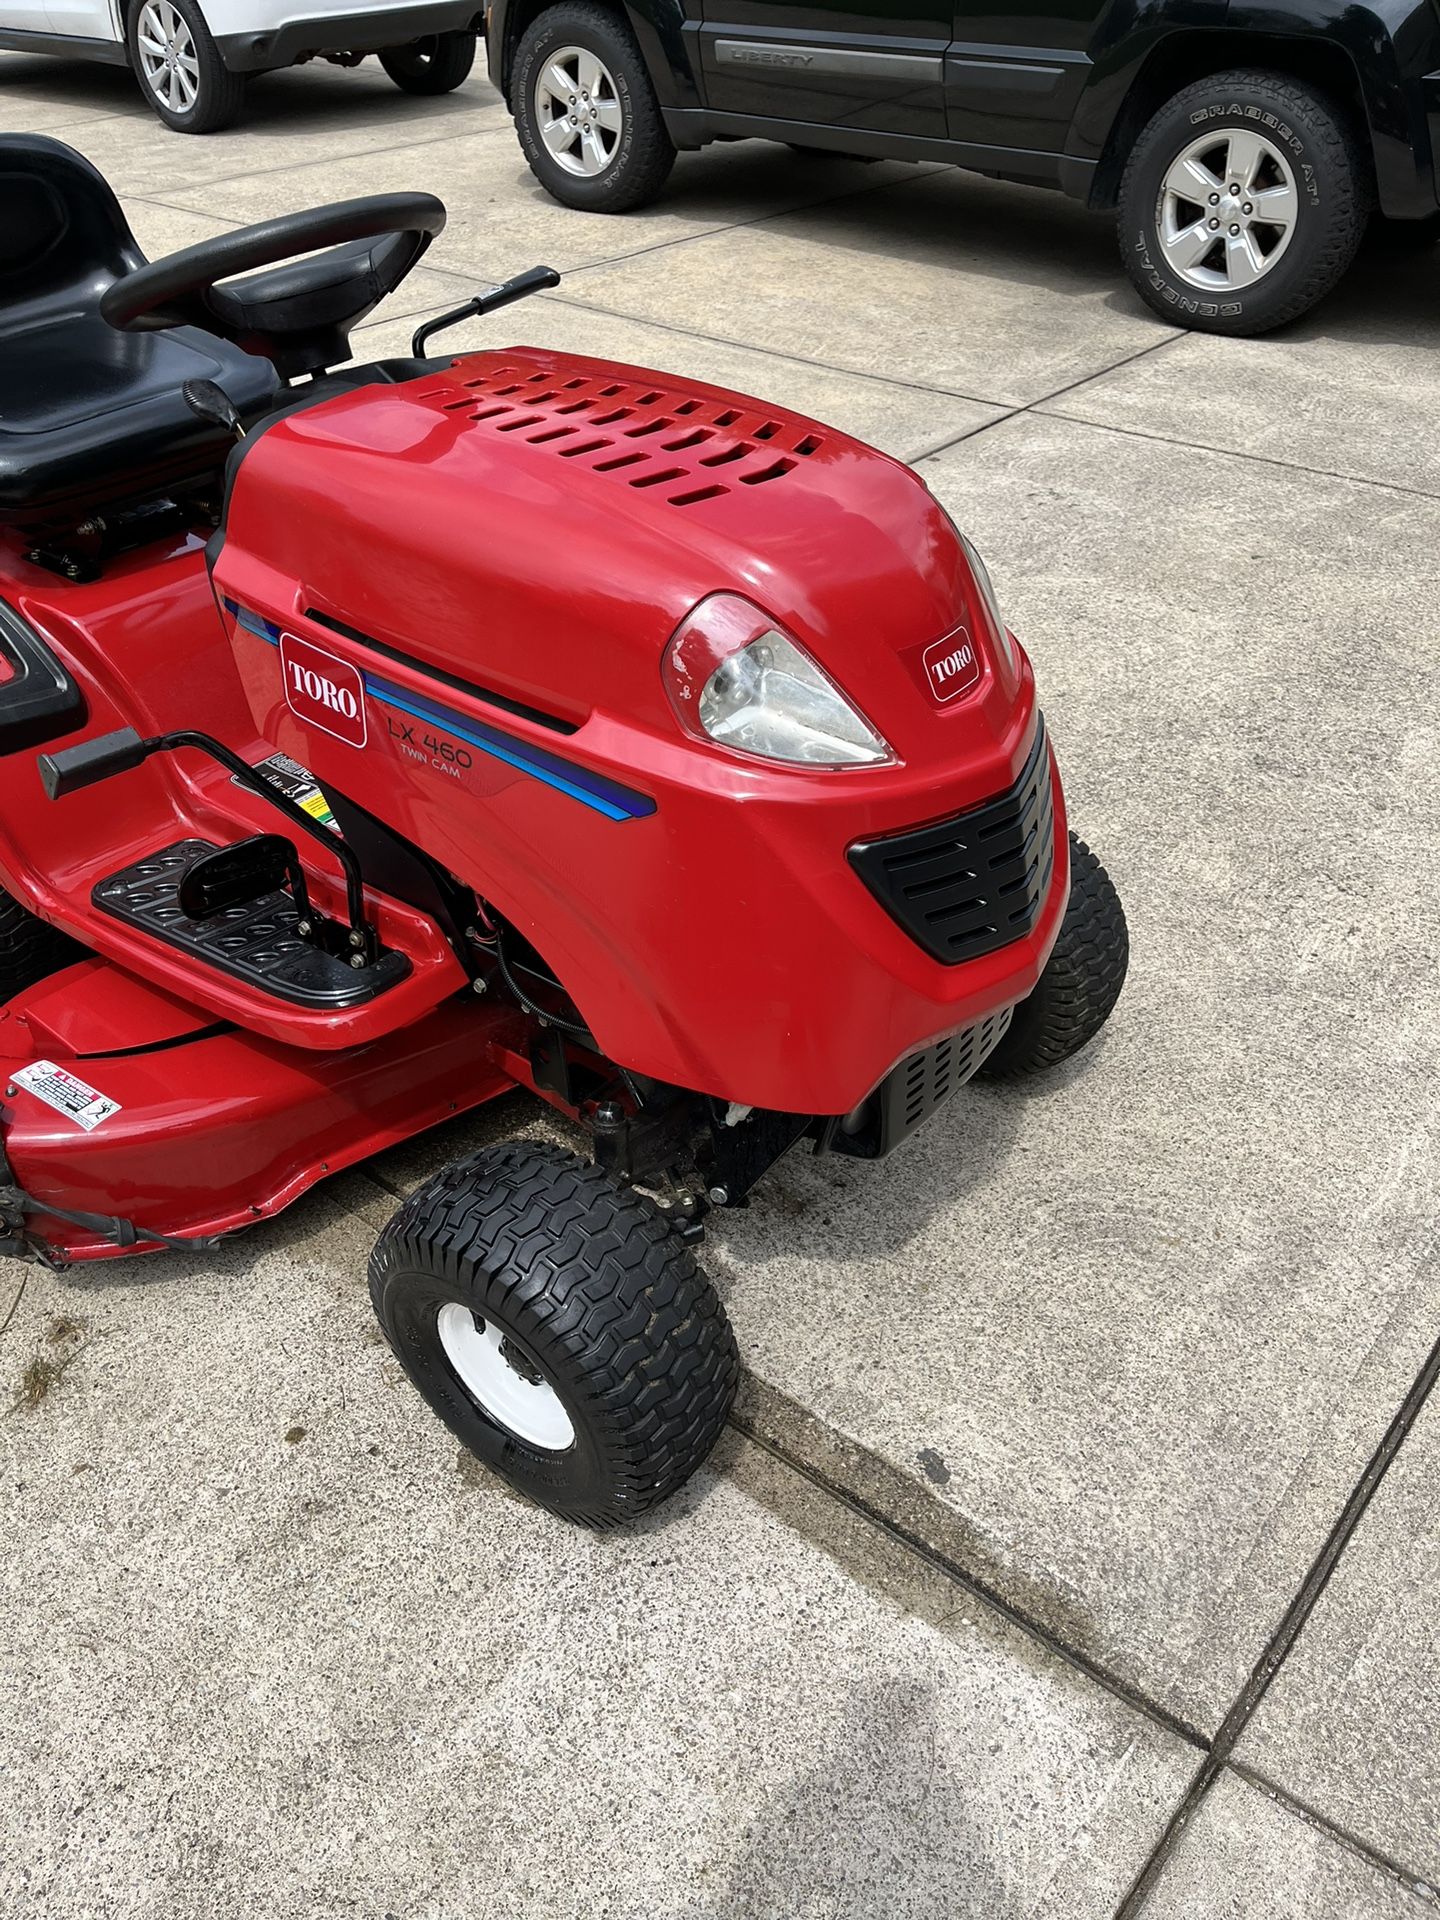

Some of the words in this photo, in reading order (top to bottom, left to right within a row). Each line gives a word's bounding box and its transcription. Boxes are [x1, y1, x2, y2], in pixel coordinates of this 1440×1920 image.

[731, 48, 814, 66] LIBERTY
[1190, 103, 1304, 156] GRABBER
[1135, 231, 1242, 317] GENERAL
[288, 660, 357, 719] TORO
[931, 644, 973, 683] TORO
[387, 717, 415, 746] LX
[423, 734, 473, 769] 460
[400, 743, 428, 764] TWIN
[431, 758, 461, 778] CAM
